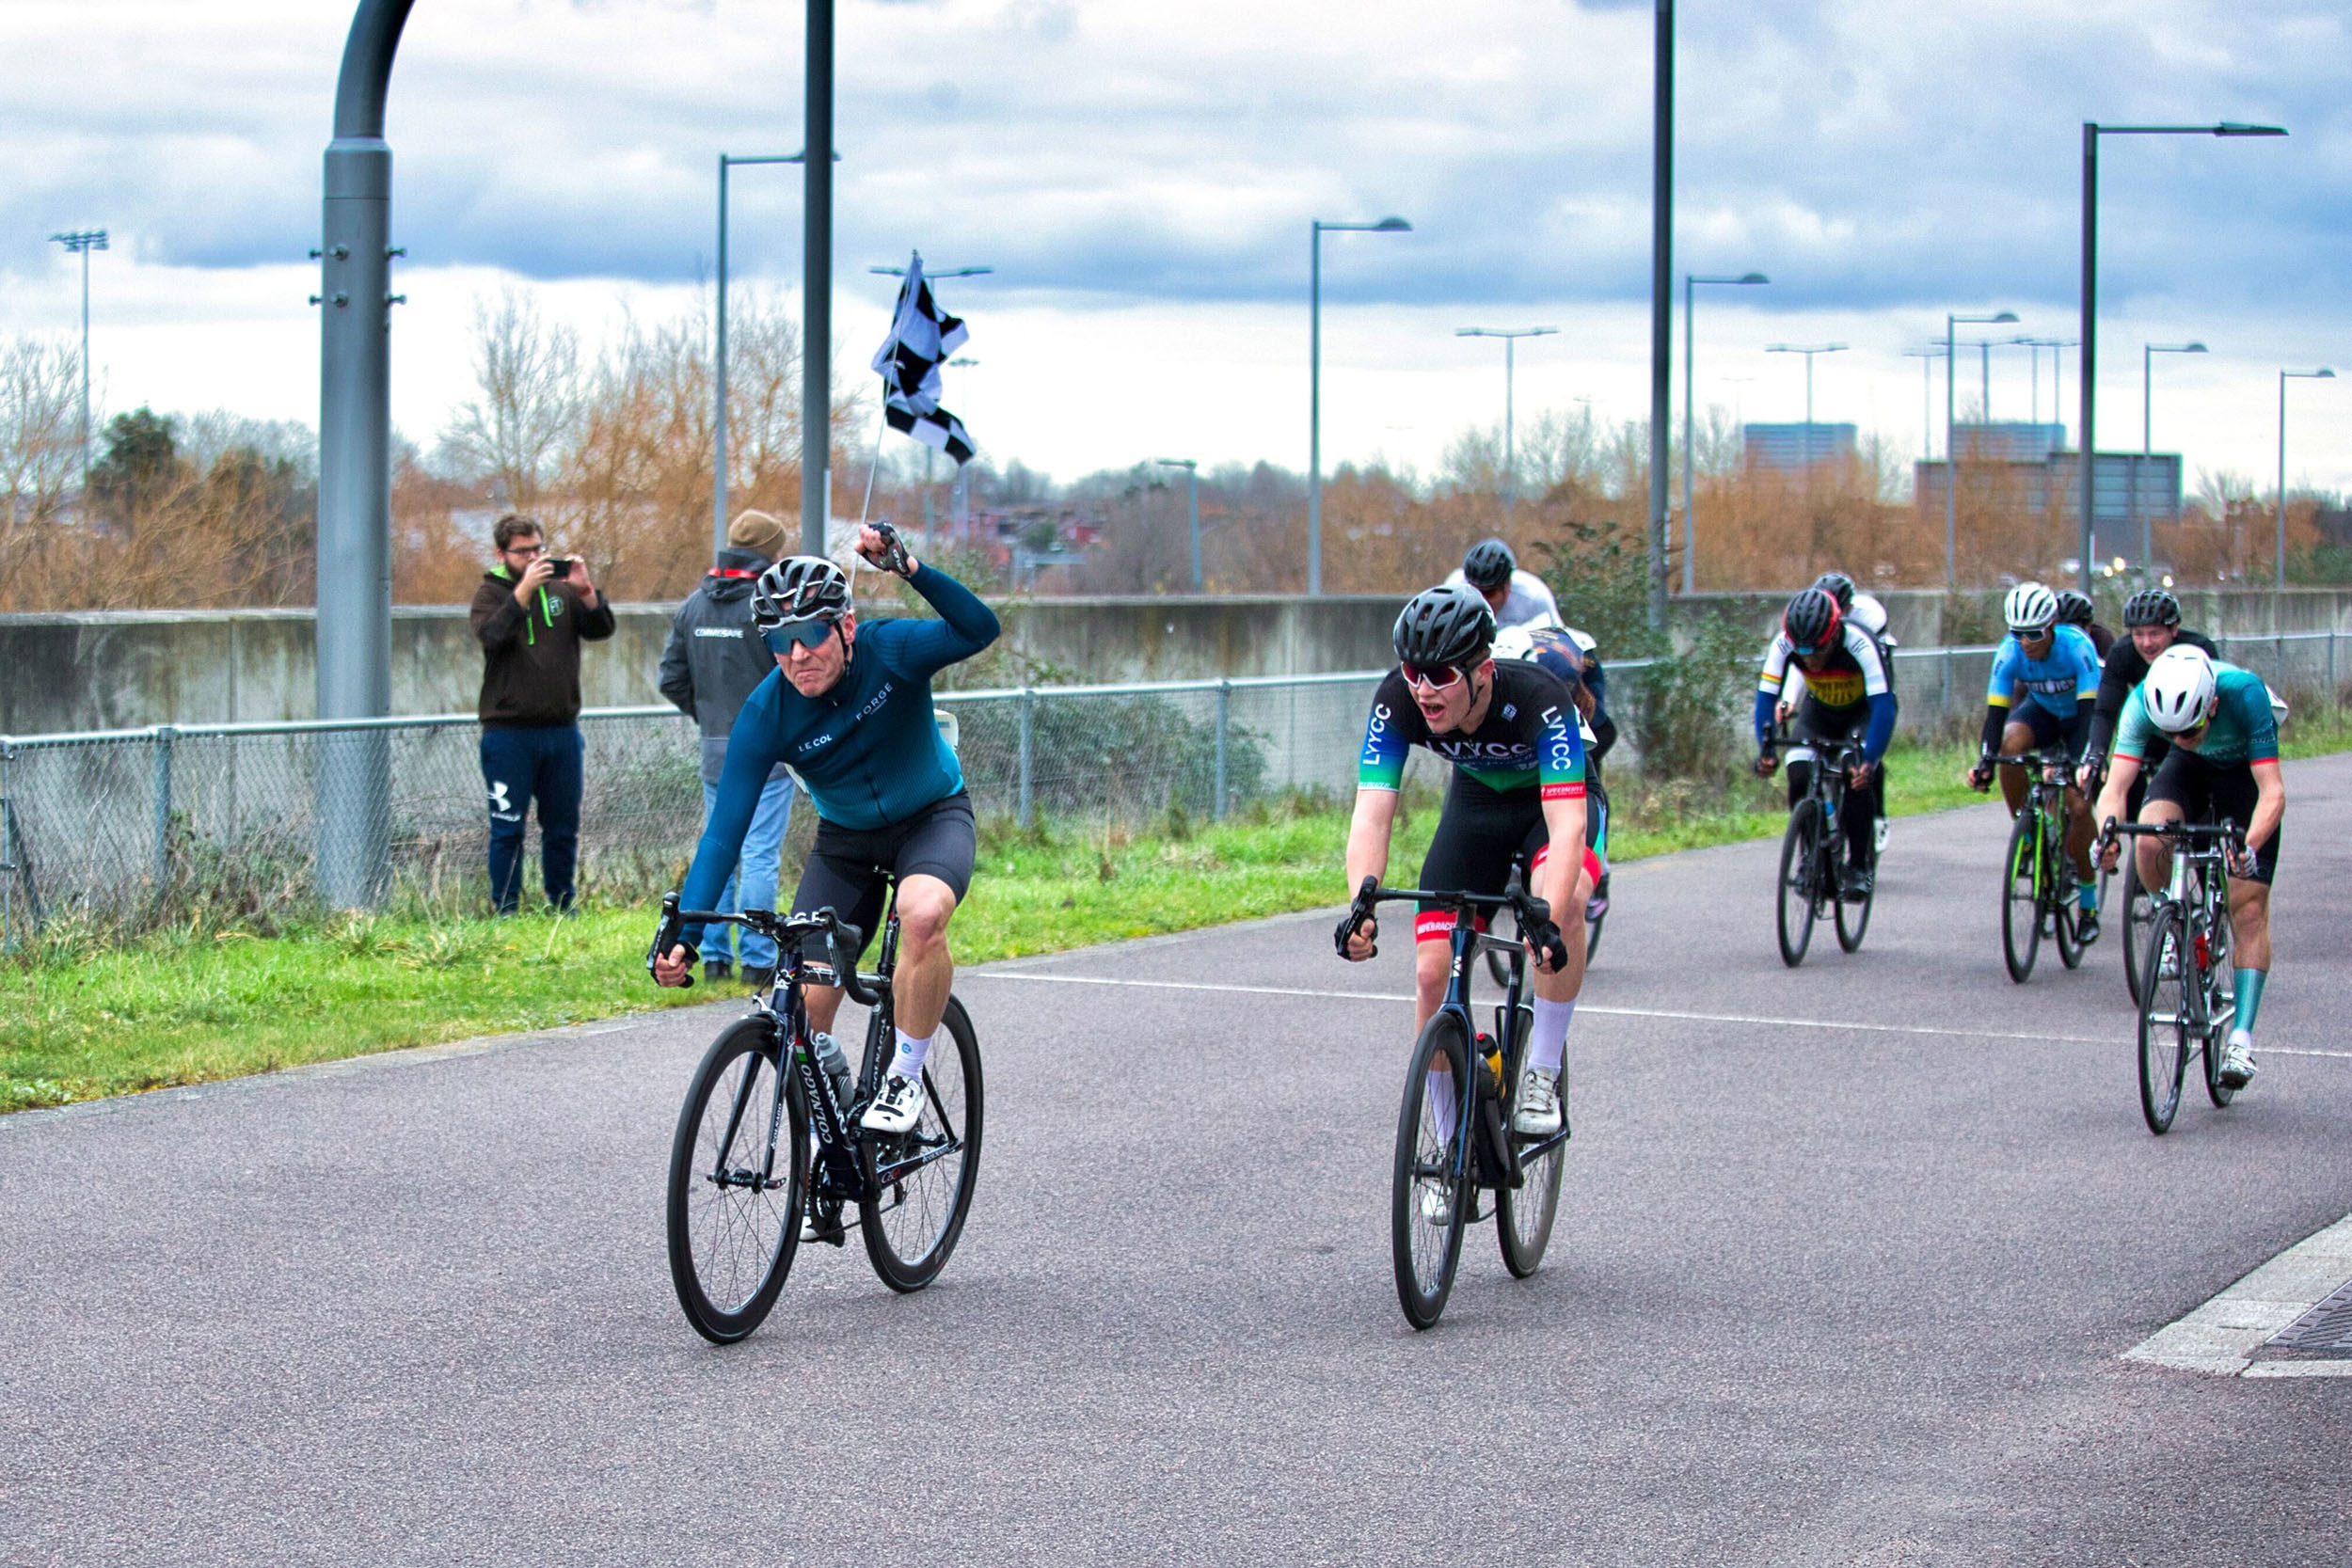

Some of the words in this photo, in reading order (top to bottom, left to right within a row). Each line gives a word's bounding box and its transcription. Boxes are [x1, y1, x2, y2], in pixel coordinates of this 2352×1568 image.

[856, 682, 894, 721] FORGE
[798, 741, 813, 752] LE
[812, 734, 833, 747] COL
[1541, 705, 1571, 770] LVYCC
[801, 1064, 834, 1145] COLNAGO
